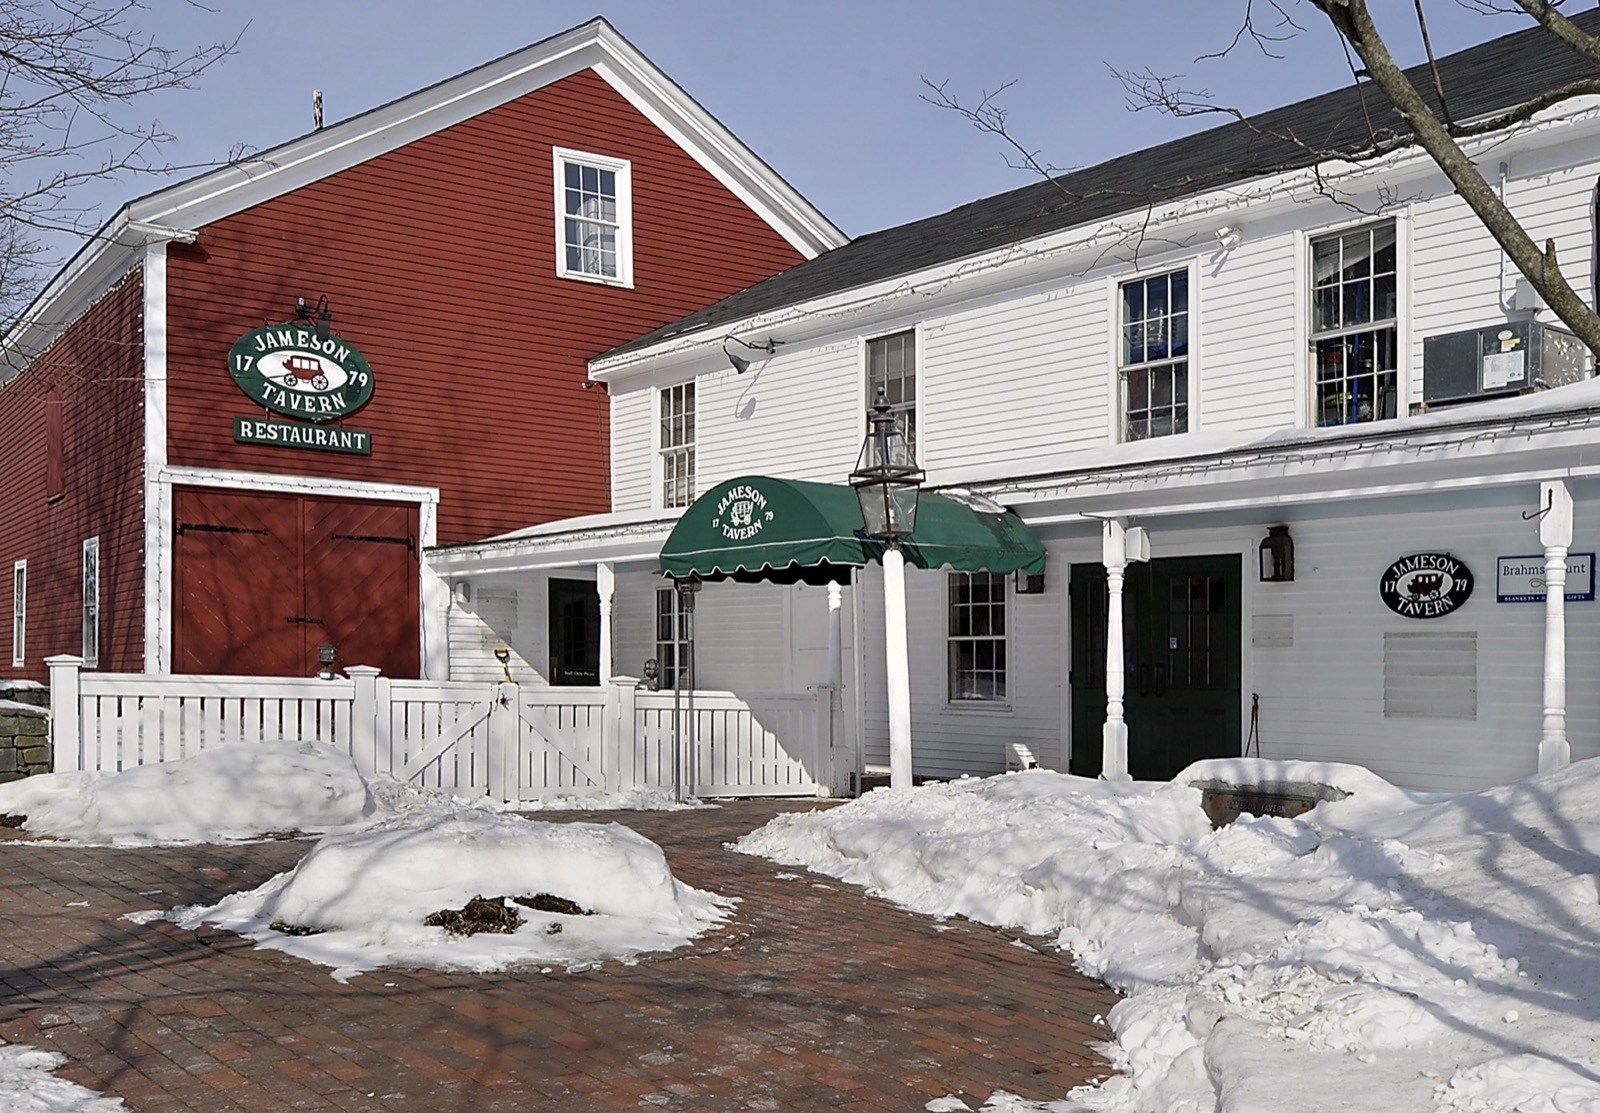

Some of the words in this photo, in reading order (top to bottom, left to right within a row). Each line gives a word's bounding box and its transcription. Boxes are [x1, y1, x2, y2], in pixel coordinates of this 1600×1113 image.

[255, 330, 350, 363] JAMESON
[235, 354, 254, 372] 17
[348, 370, 368, 387] 79
[262, 382, 346, 413] TAVERN
[240, 420, 366, 450] RESTAURANT
[717, 485, 767, 516] JAMESON
[712, 518, 720, 528] 17
[764, 510, 775, 521] 79
[722, 519, 763, 540] TAVERN
[1392, 555, 1459, 579] JAMESON
[1503, 564, 1545, 576] Brahms
[1384, 580, 1396, 593] 17
[1454, 578, 1468, 592] 79
[1397, 595, 1454, 616] TAVERN
